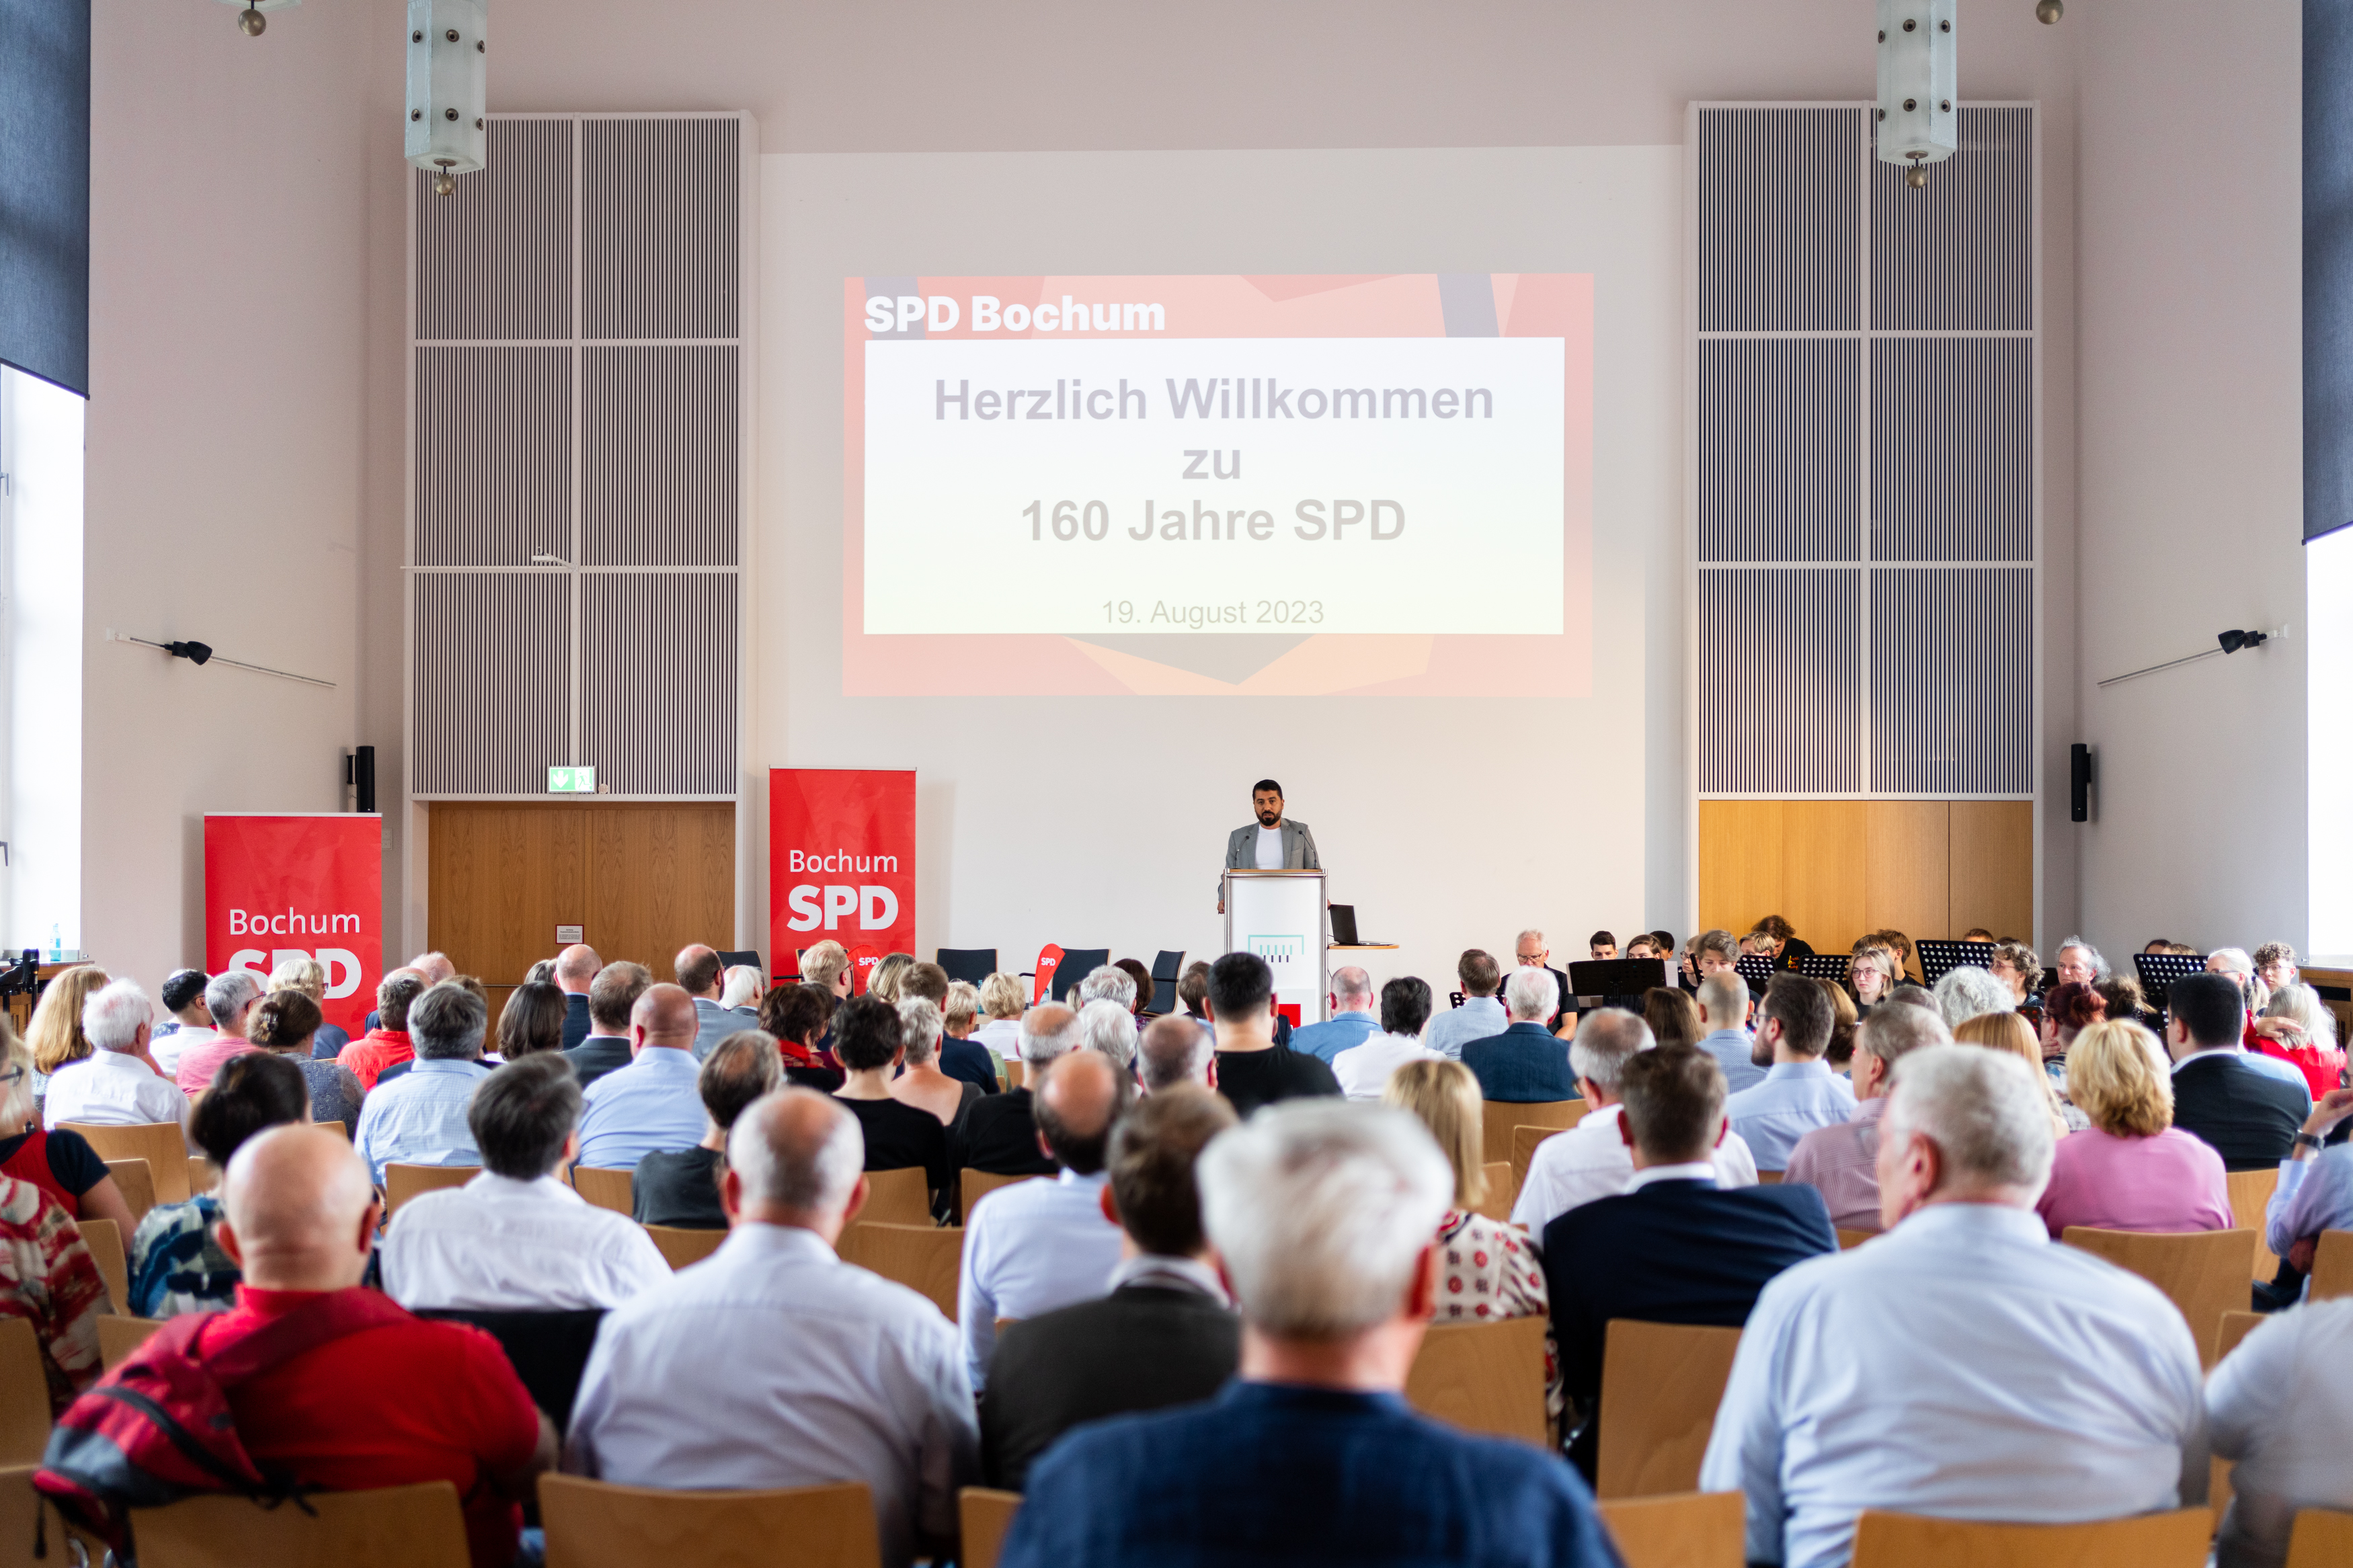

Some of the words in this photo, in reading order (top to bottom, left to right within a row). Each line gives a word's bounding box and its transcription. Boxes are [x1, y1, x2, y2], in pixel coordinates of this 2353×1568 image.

[864, 296, 960, 333] SPD
[971, 295, 1166, 331] Bochum
[935, 378, 1147, 420] Herzlich
[1165, 378, 1494, 419] Willkommen
[1182, 449, 1241, 480] zu
[1022, 499, 1110, 542] 160
[1127, 499, 1275, 542] Jahre
[1293, 499, 1406, 541] SPD
[1102, 600, 1142, 624] 19.
[1150, 600, 1247, 630] August
[1256, 600, 1324, 624] 2023
[790, 848, 898, 873] Bochum
[229, 907, 361, 936] Bochum
[787, 884, 899, 932] SPD
[859, 956, 879, 966] SPD
[1041, 957, 1055, 966] SPD
